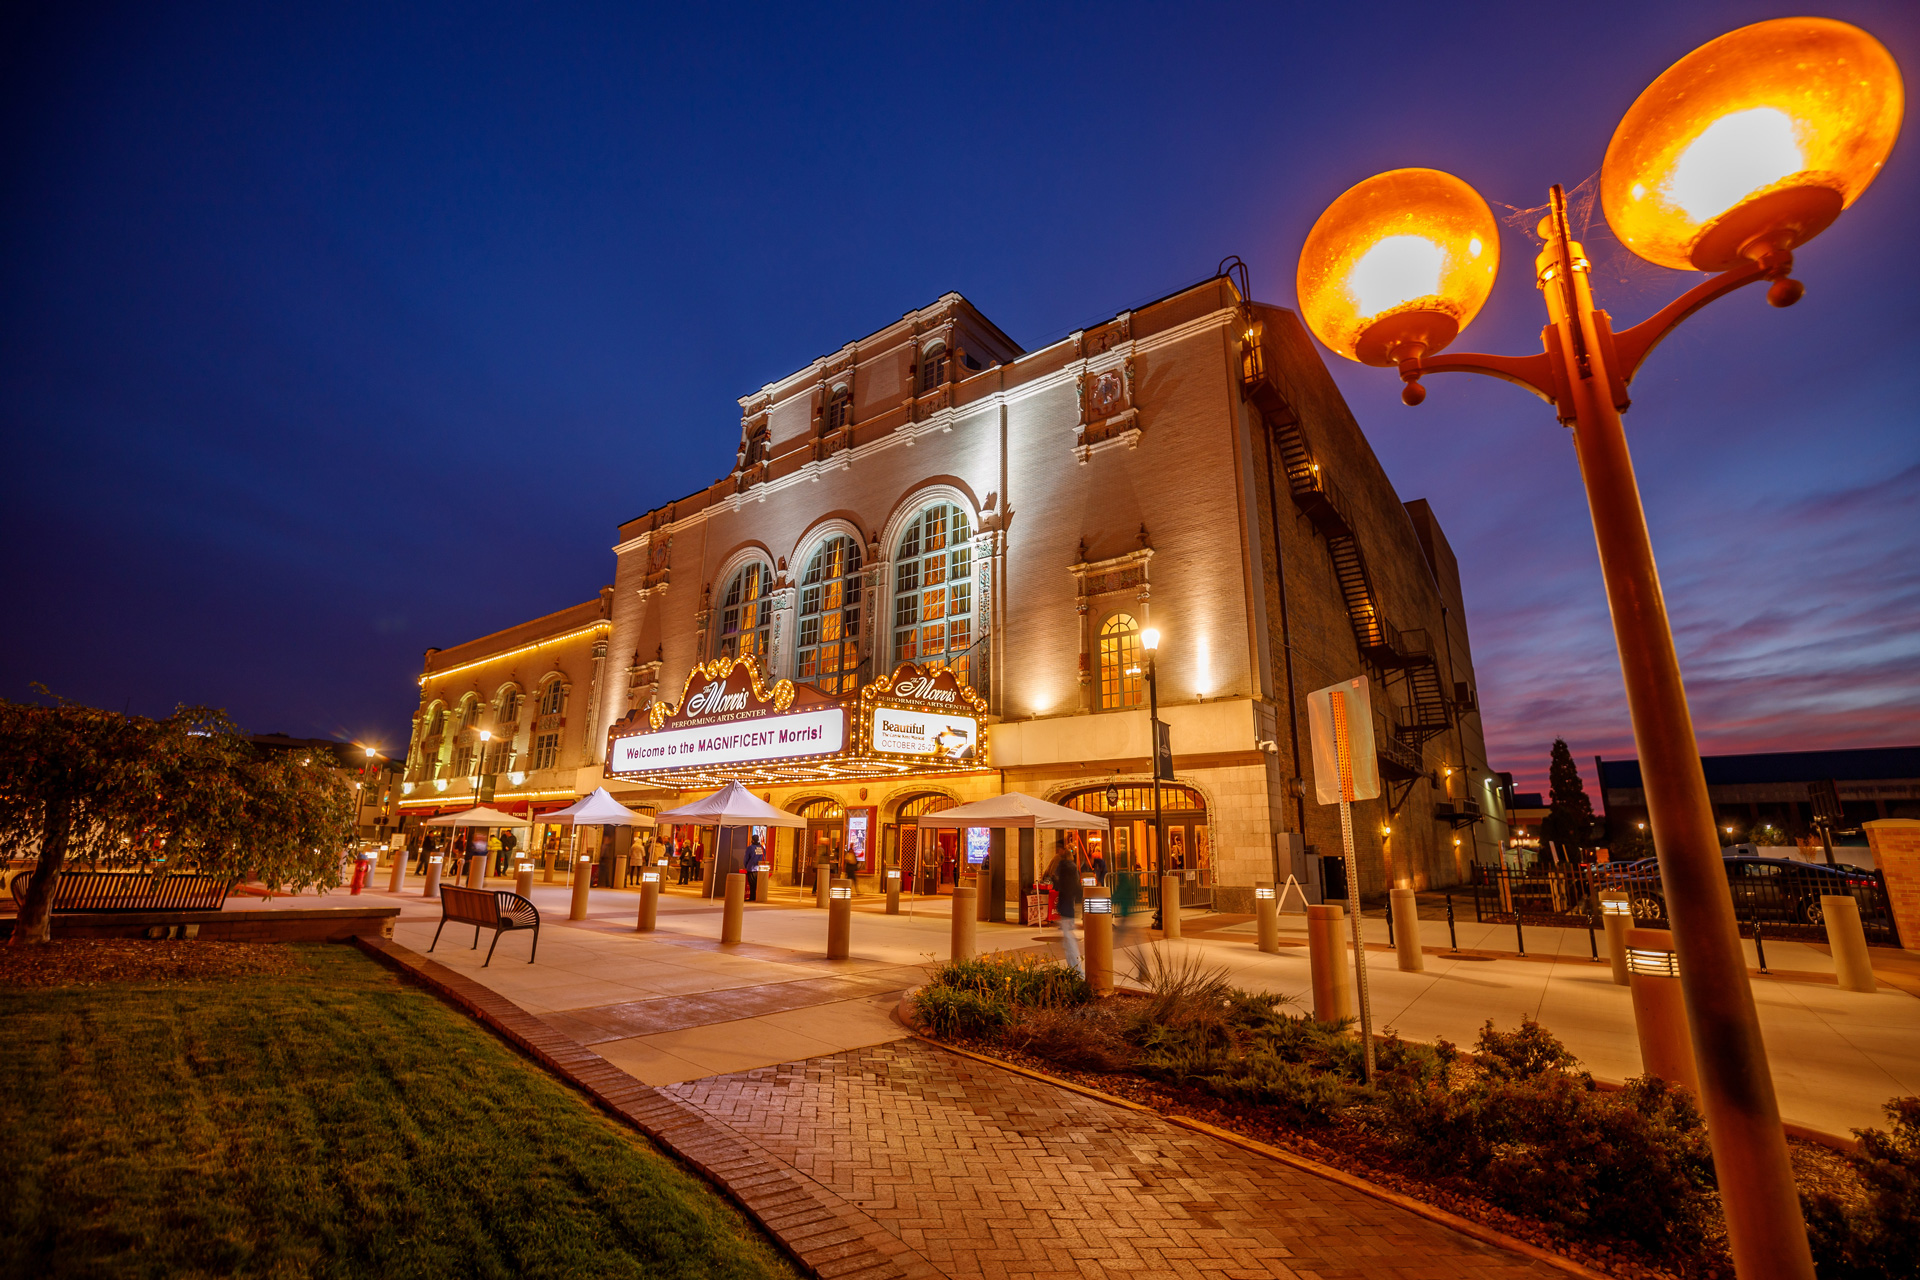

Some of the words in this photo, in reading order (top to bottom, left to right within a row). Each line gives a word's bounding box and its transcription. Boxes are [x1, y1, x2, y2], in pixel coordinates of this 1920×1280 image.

[703, 685, 712, 694] The
[895, 676, 957, 703] Morris
[686, 680, 749, 718] Morris
[877, 695, 926, 706] PERFORMING
[944, 703, 971, 711] CENTER
[671, 716, 716, 729] PERFORMING
[717, 713, 735, 722] ARTS
[735, 708, 767, 720] CENTER
[882, 720, 925, 735] Beautiful
[626, 746, 665, 760] Welcome
[668, 744, 677, 756] to
[680, 741, 695, 754] the
[698, 730, 775, 752] MAGNIFICENT
[778, 724, 823, 744] Morris!
[881, 739, 916, 750] OCTOBER
[917, 743, 936, 752] 25-27
